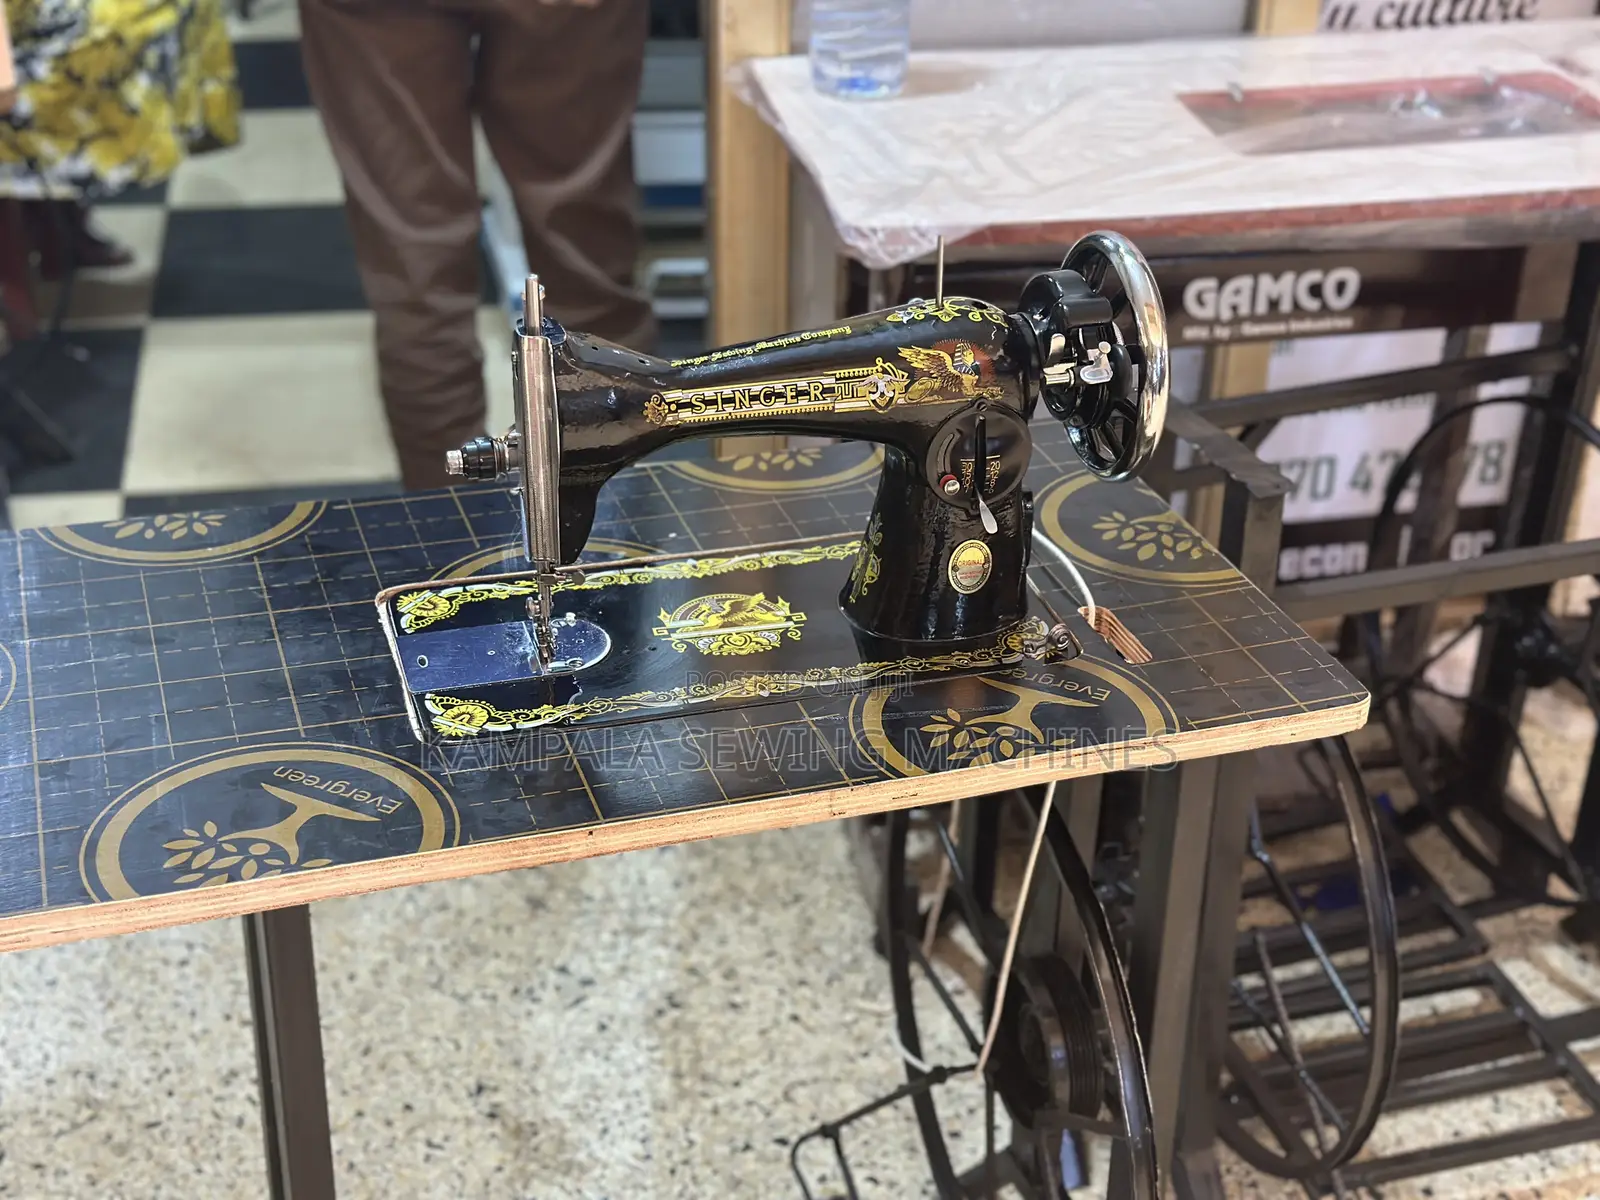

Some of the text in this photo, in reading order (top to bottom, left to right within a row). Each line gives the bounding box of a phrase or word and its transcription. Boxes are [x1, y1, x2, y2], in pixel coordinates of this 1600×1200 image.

[1182, 266, 1361, 323] GAMCO
[801, 325, 852, 341] Company
[690, 380, 826, 415] SINGER
[990, 460, 1001, 471] 20
[1000, 666, 1112, 701] Evergree
[273, 765, 404, 814] Evergreen
